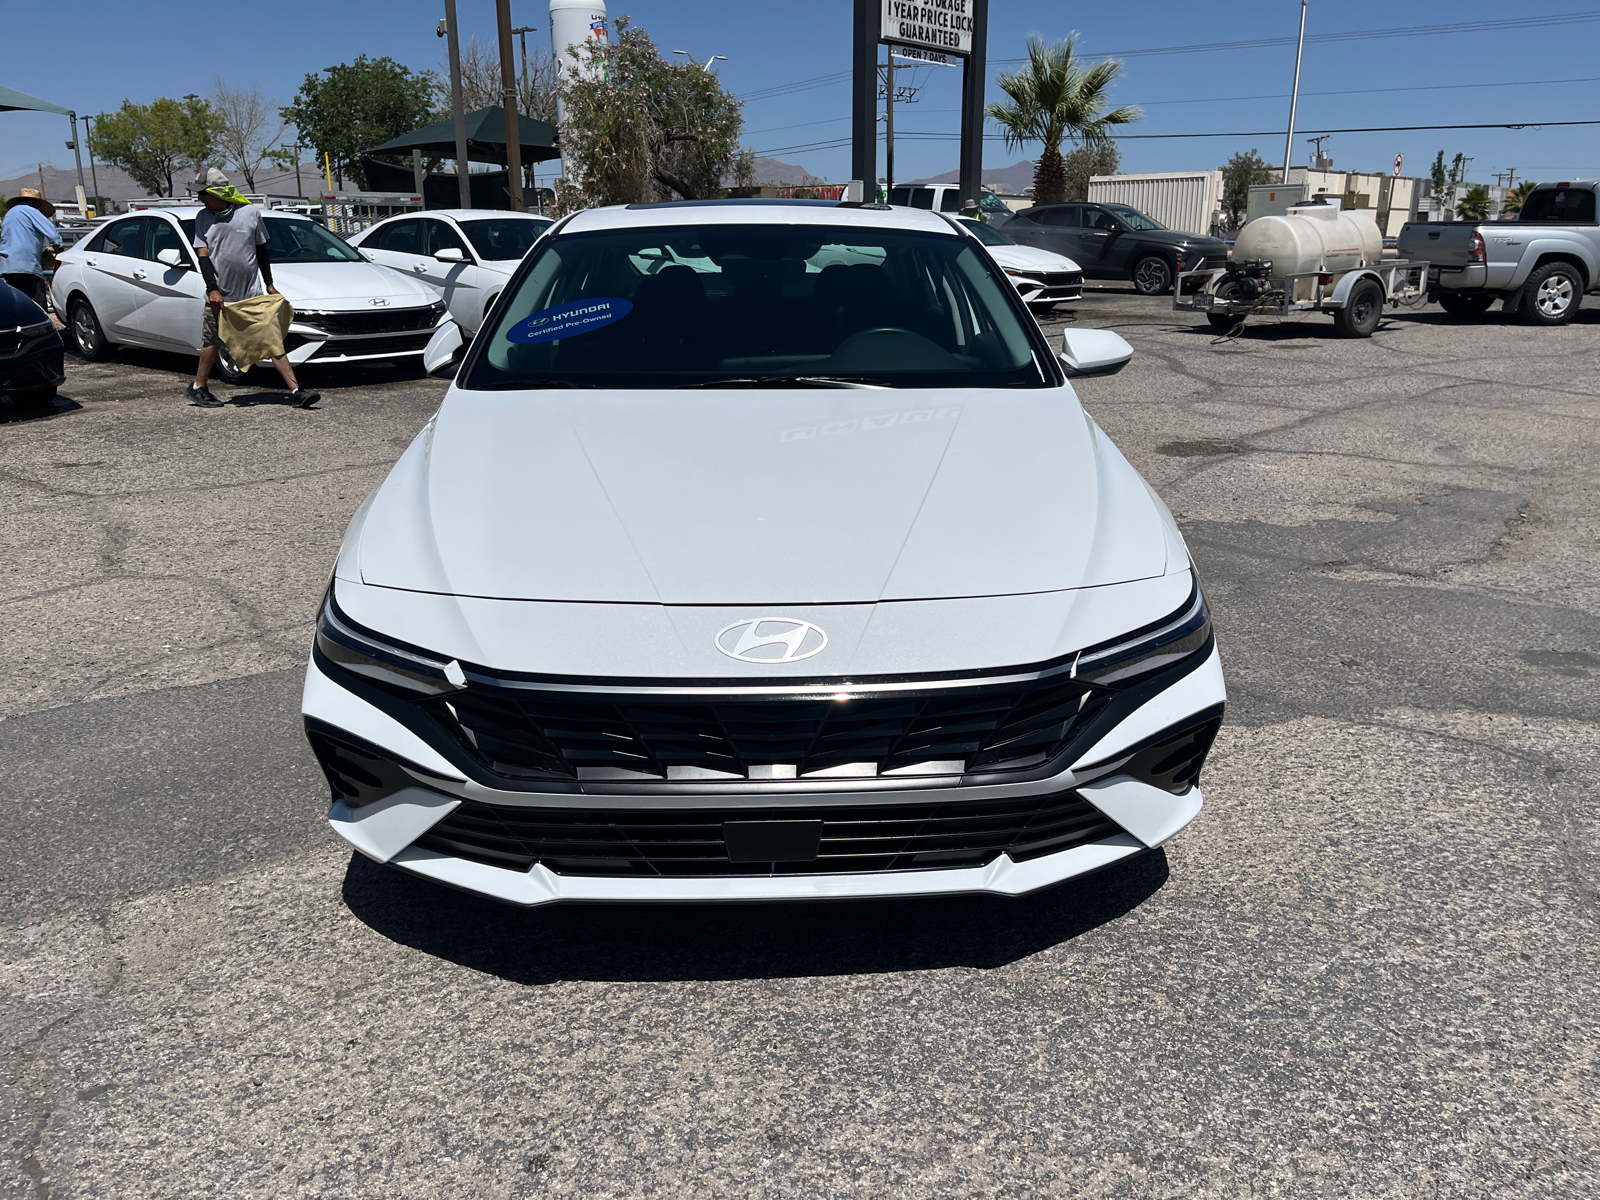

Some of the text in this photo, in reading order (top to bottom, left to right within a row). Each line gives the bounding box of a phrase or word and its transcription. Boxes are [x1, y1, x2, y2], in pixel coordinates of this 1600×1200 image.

[894, 2, 919, 21] YEAR
[920, 8, 948, 27] PRICE
[950, 14, 973, 32] LOCK
[899, 22, 960, 47] GUARANTEED
[902, 48, 922, 60] OPEN
[929, 52, 947, 64] DAYS
[552, 303, 610, 322] HYUNDAI
[527, 313, 612, 338] Certified Pre-Owned
